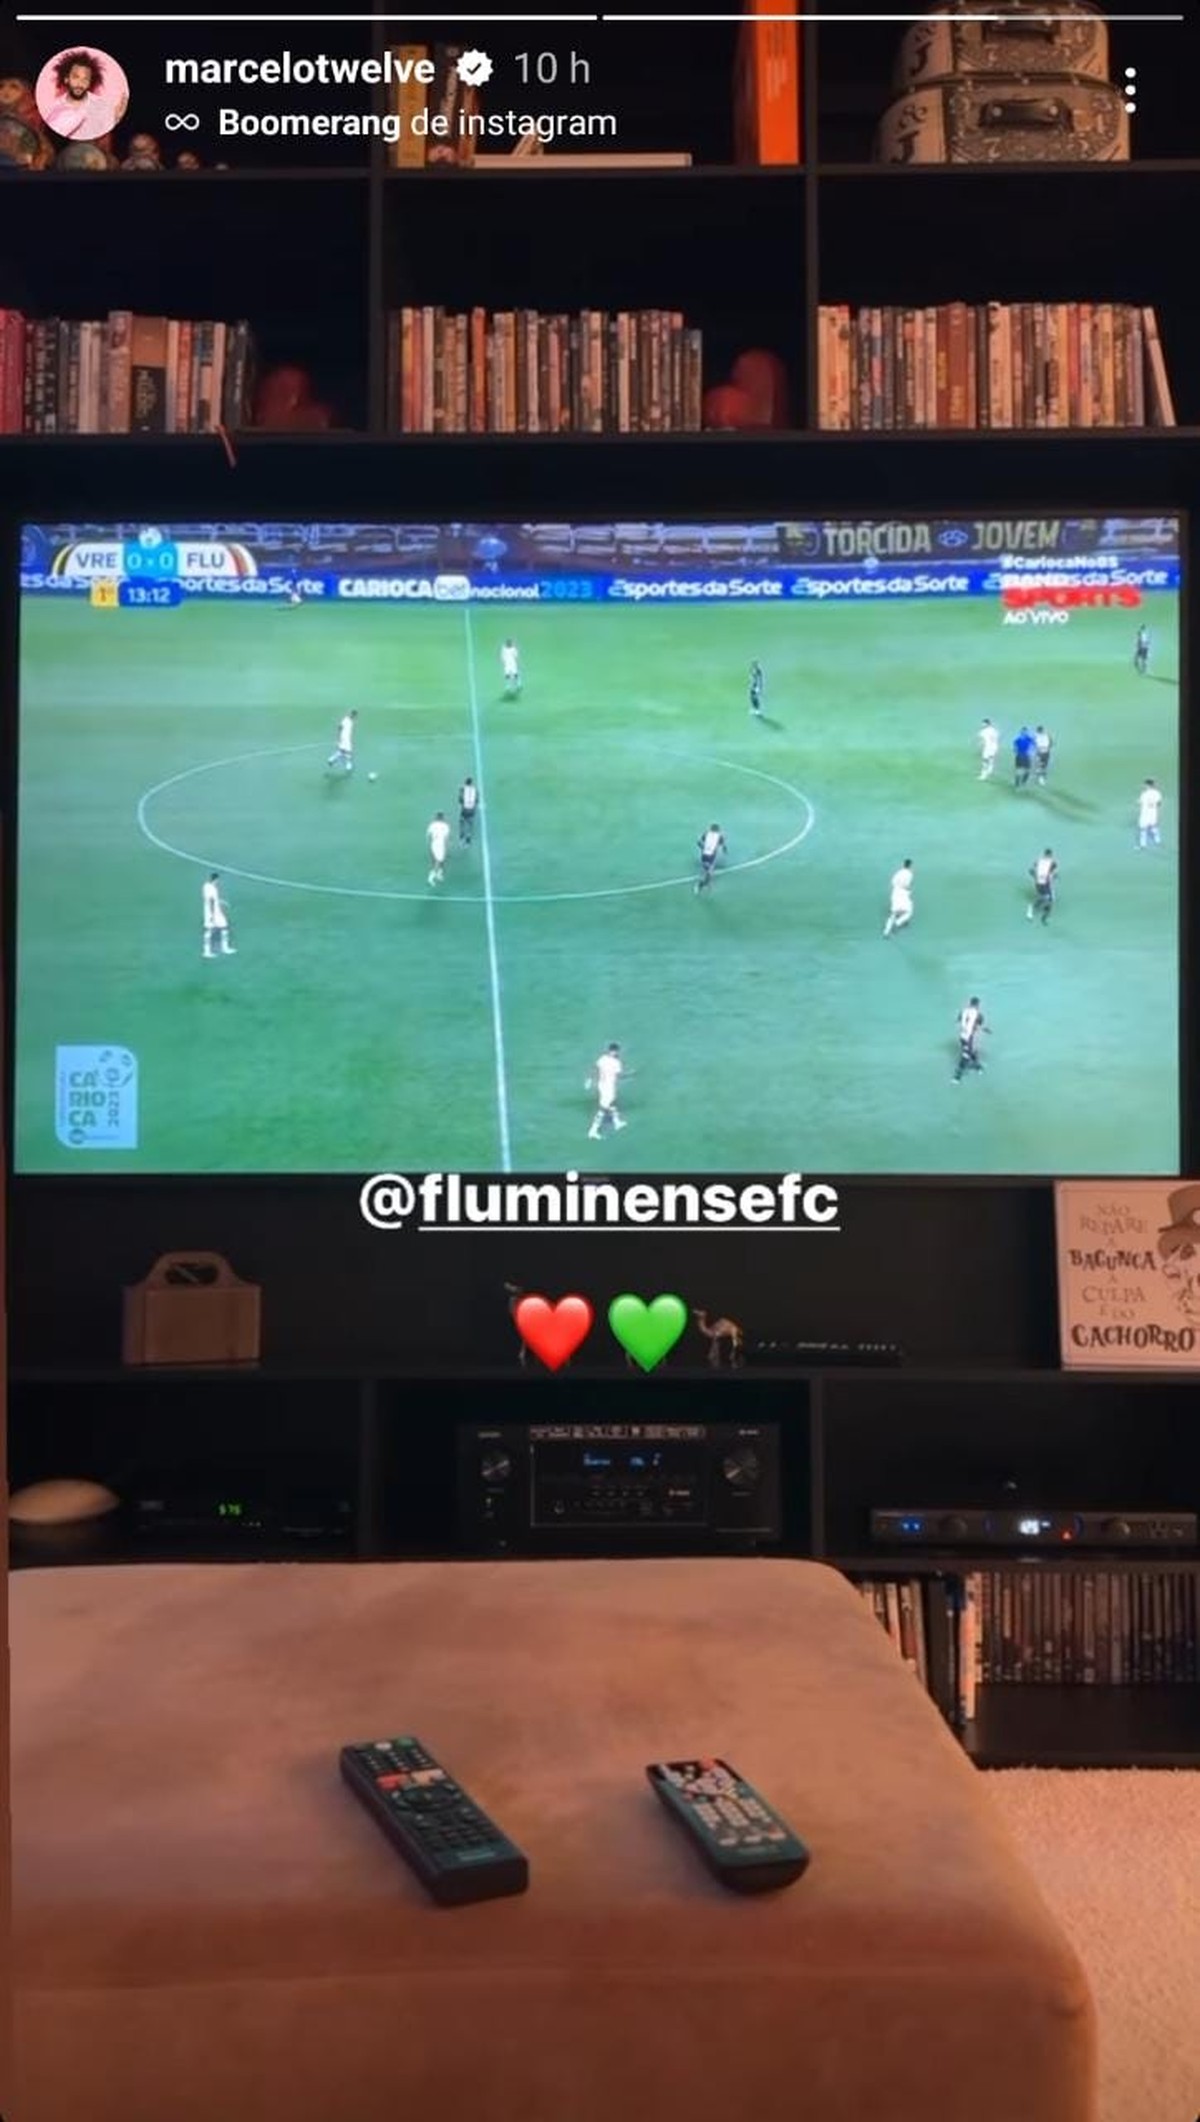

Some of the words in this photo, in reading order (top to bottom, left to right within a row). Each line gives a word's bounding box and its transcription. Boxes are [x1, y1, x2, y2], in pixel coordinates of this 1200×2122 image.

[823, 523, 931, 556] TORCIDA
[972, 520, 1061, 550] JOVEM
[75, 552, 118, 569] VRE
[186, 552, 226, 569] FLU
[127, 586, 172, 603] 13:12
[338, 578, 432, 599] CARIOCA
[541, 580, 593, 599] 2023
[1081, 1286, 1148, 1303] CULPA
[1071, 1323, 1195, 1353] CACHORRO
